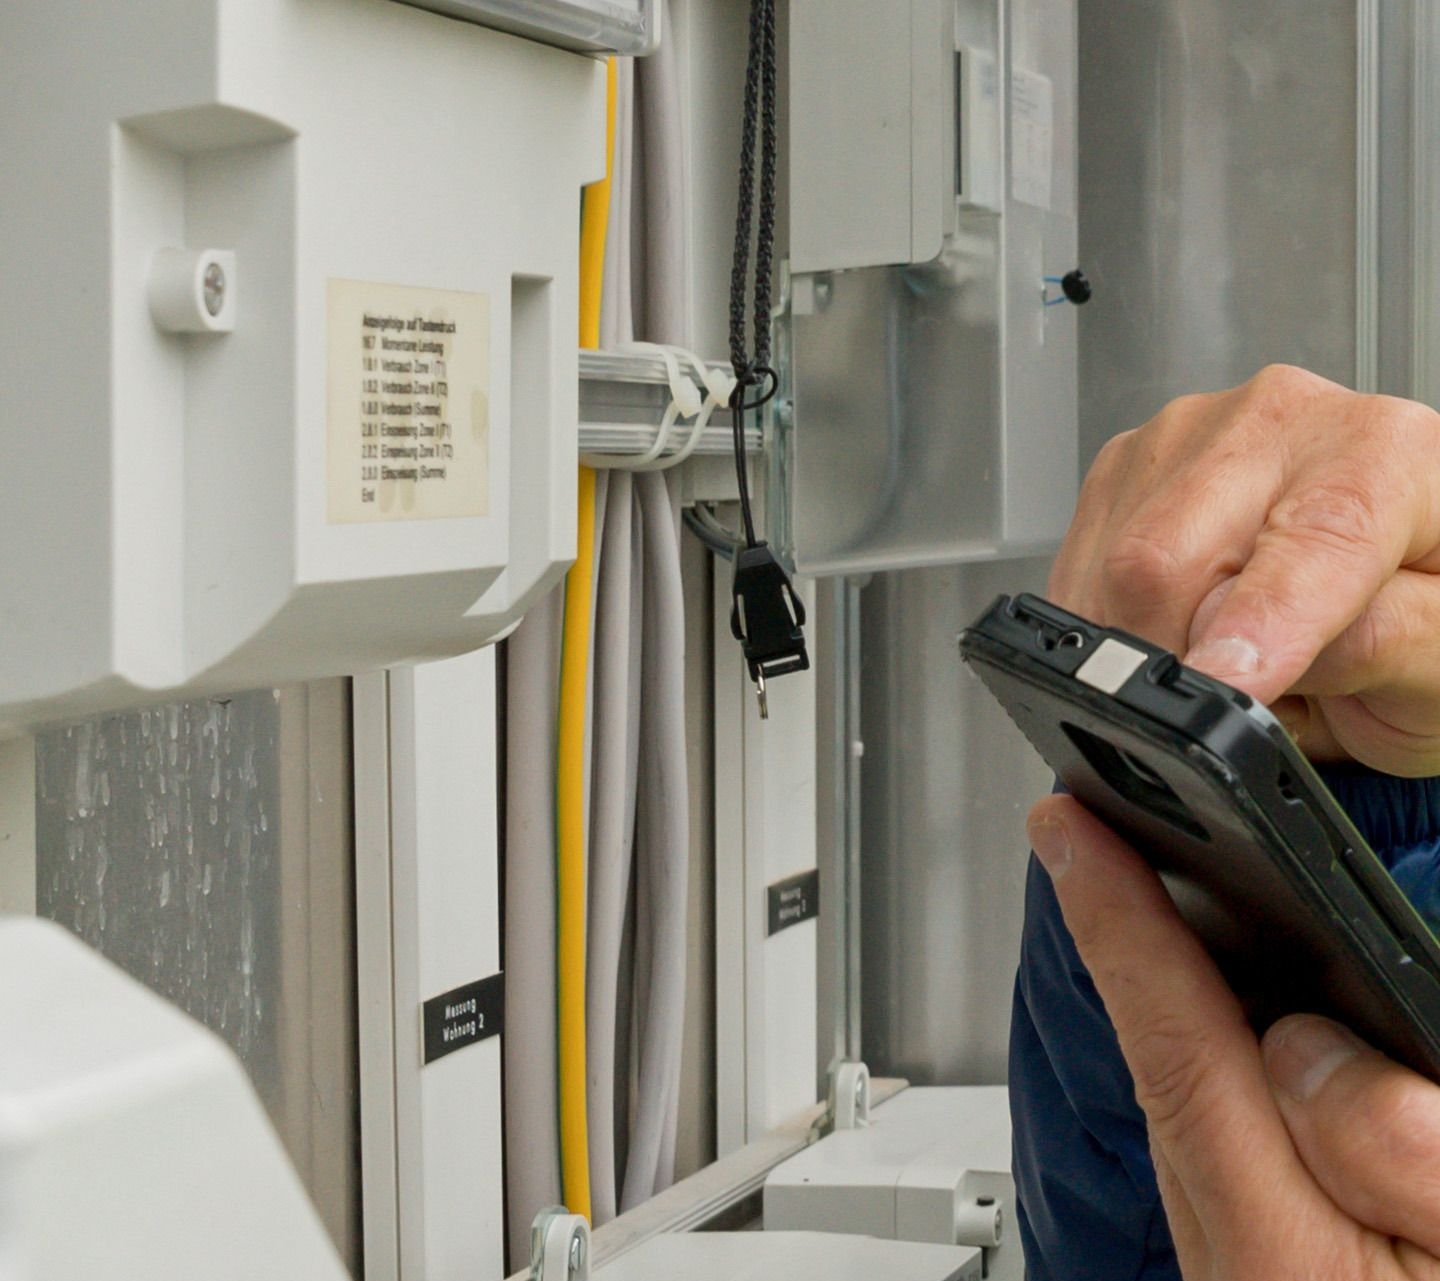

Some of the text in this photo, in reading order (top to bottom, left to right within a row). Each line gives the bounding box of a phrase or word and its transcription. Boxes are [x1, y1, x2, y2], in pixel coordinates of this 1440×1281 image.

[445, 998, 477, 1020] Messung
[443, 1012, 484, 1042] Wohnung 2
